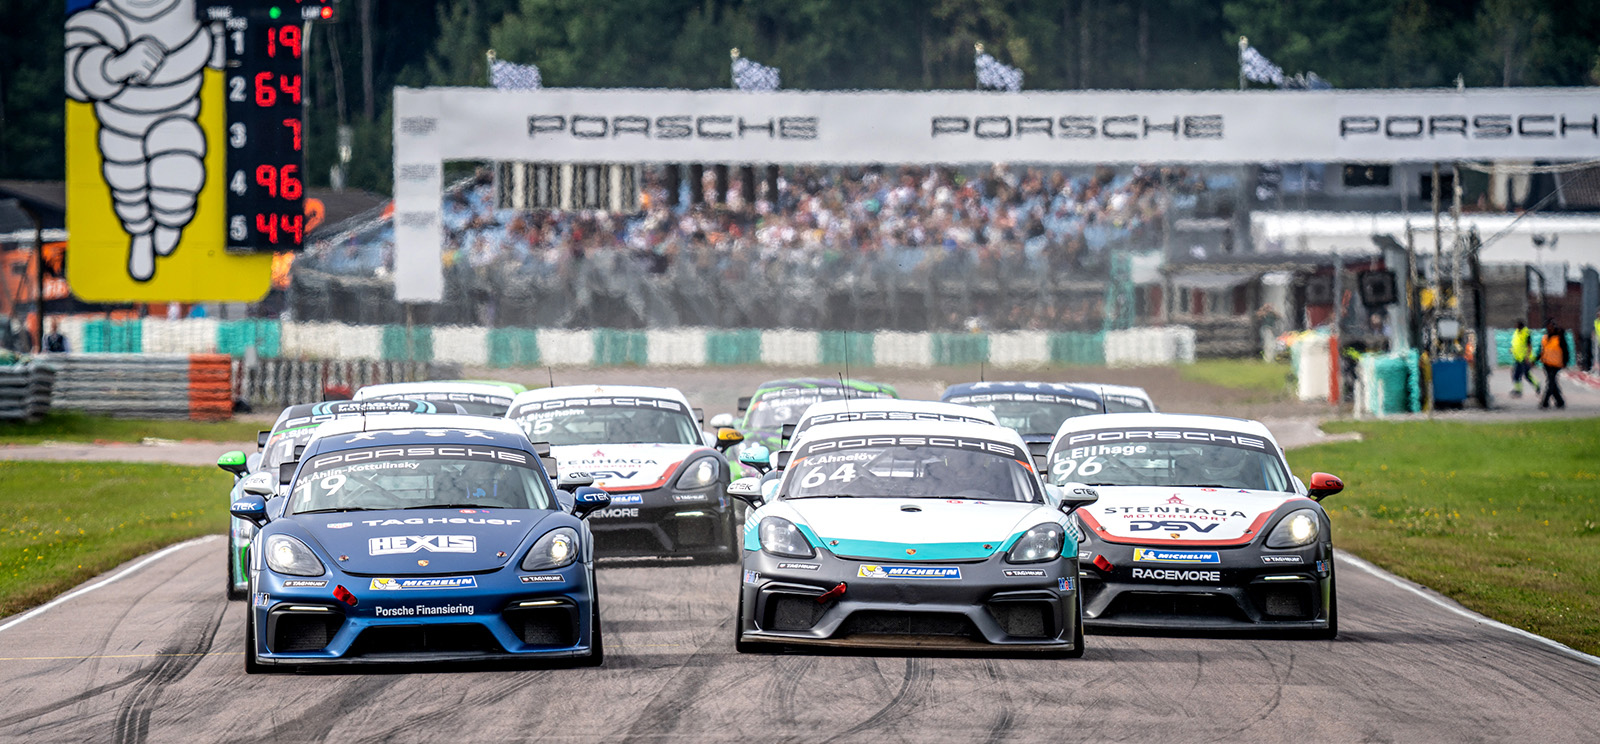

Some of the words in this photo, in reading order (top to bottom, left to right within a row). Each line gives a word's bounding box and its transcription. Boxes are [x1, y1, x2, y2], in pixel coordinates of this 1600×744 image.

[231, 30, 245, 55] 1
[267, 25, 302, 58] 19
[229, 76, 247, 102] 2
[255, 71, 302, 107] 64
[229, 122, 247, 149] 3
[283, 118, 302, 152] 7
[527, 115, 819, 140] PORSCHE
[930, 114, 1224, 140] PORSCHE
[230, 169, 248, 196] 4
[256, 164, 303, 200] 96
[230, 214, 248, 241] 5
[256, 213, 303, 245] 44
[519, 398, 681, 414] PORSCHE
[808, 437, 1015, 456] PORSCHE
[1069, 431, 1265, 449] PORSCHE
[314, 447, 526, 469] PORSCHE
[803, 453, 878, 467] K.Ahnelöv
[1053, 445, 1147, 463] L.Ellhage
[589, 471, 638, 479] SV
[800, 463, 856, 488] 64
[1052, 457, 1102, 481] 96
[294, 474, 347, 502] 19
[231, 502, 257, 511] CTEK
[1104, 507, 1247, 519] STENHAGA
[1123, 514, 1229, 522] MOTORSPORT
[1130, 521, 1220, 533] DSV
[371, 536, 475, 552] HEXIS
[888, 567, 958, 576] MICHELIN
[1132, 568, 1220, 582] RACEMORE
[402, 577, 473, 587] MICHELIN
[375, 605, 415, 616] Porsche
[416, 604, 475, 616] Finansiering
